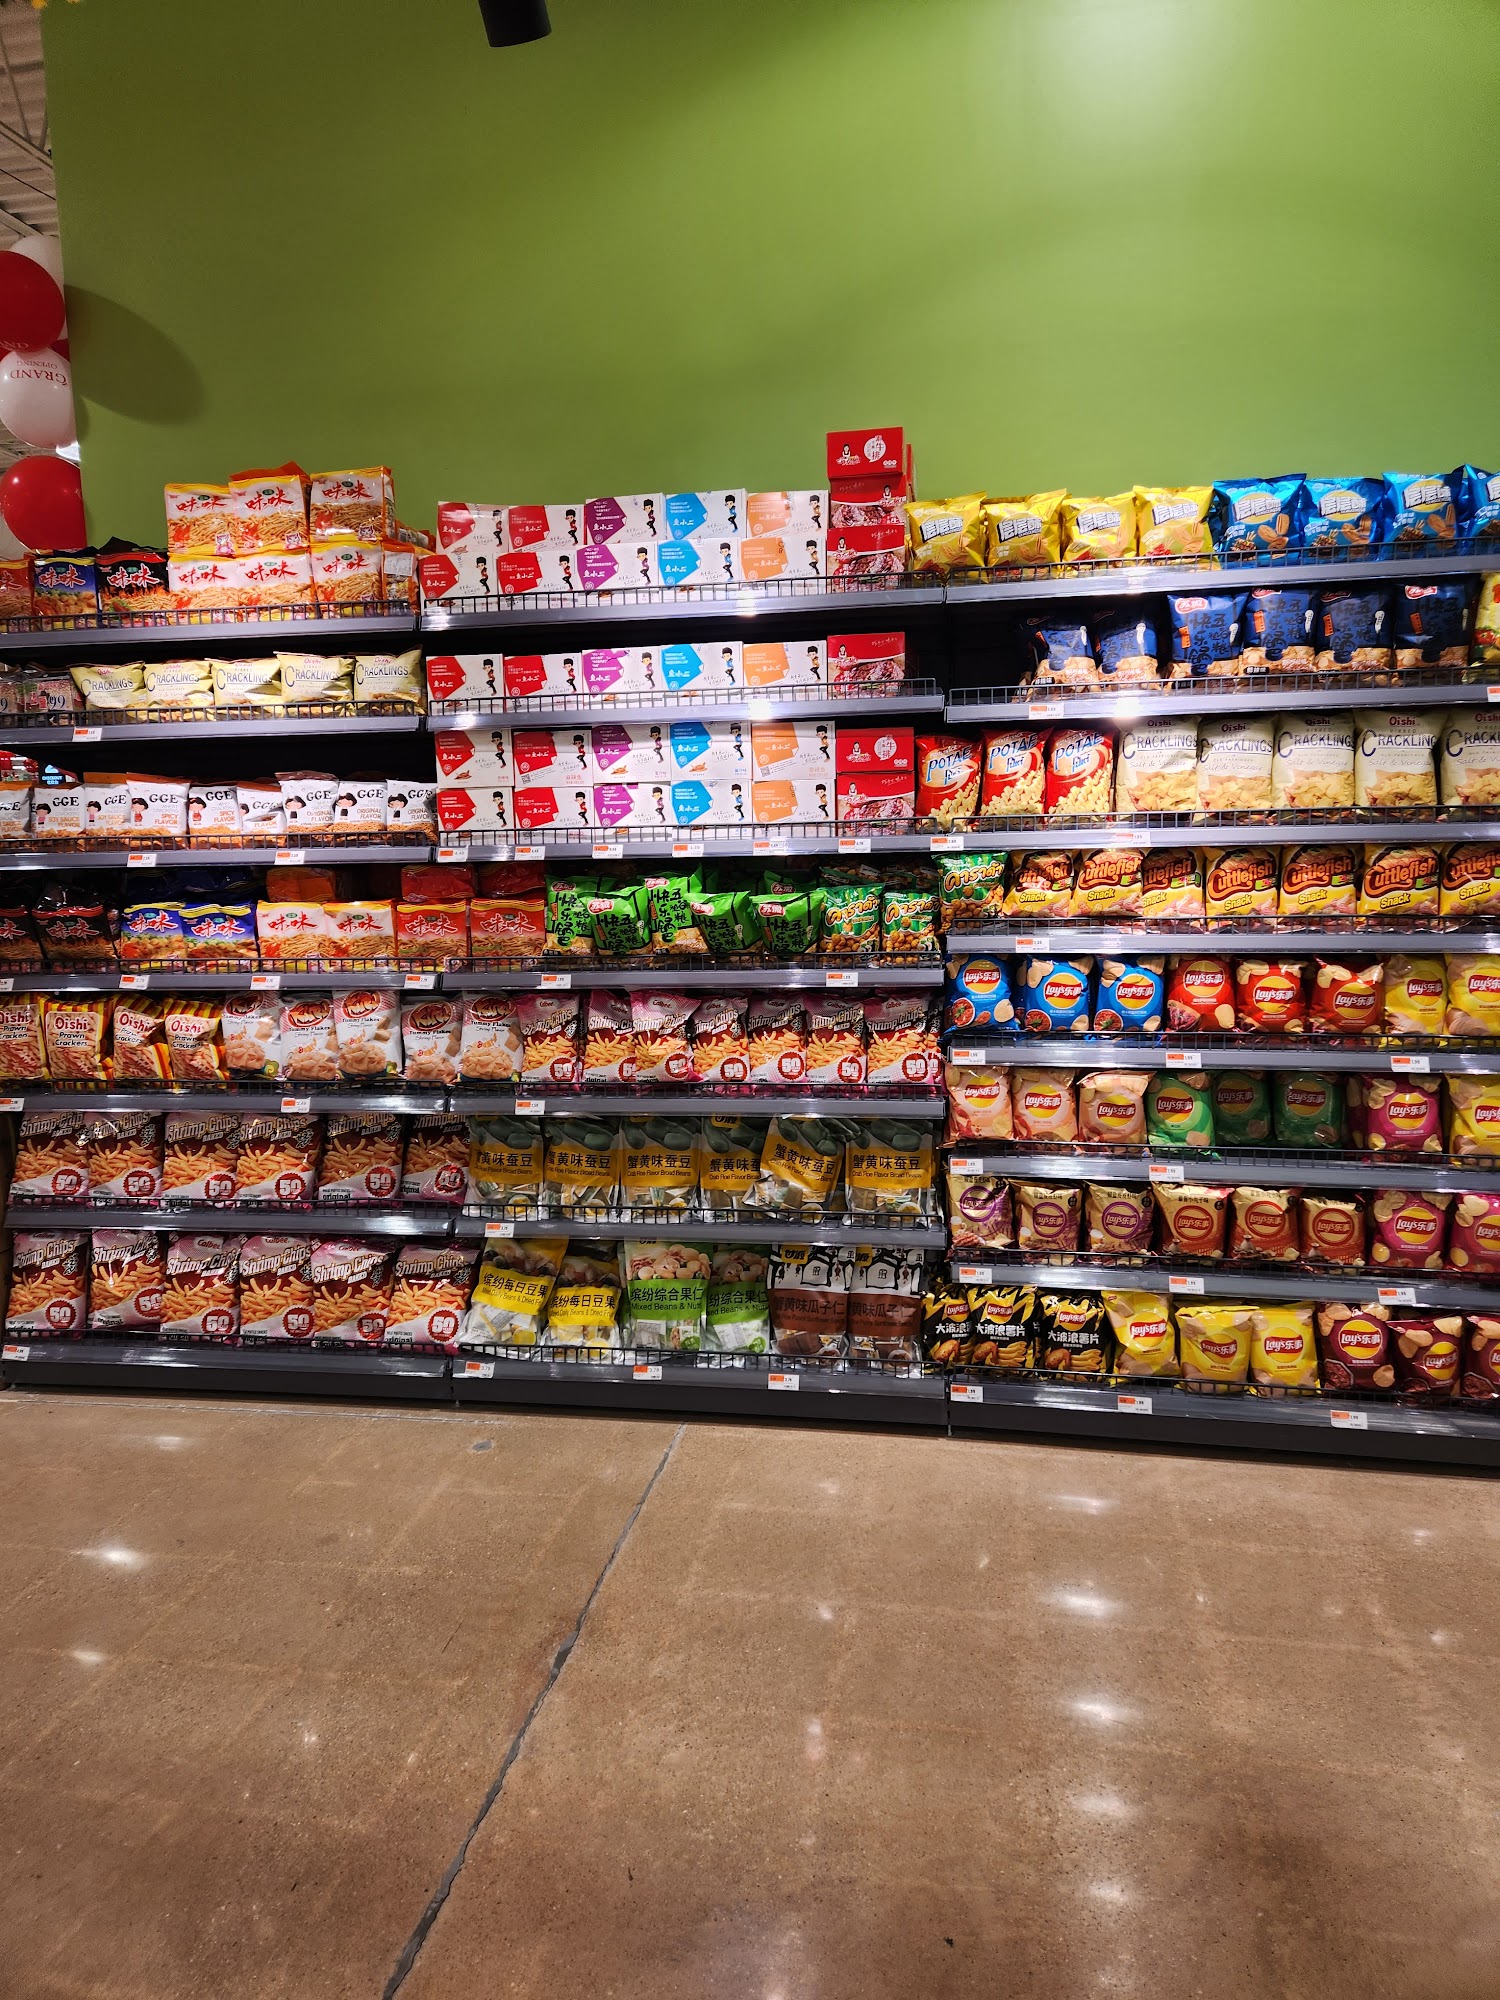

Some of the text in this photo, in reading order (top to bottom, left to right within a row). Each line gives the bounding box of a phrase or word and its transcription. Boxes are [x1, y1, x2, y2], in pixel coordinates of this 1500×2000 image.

[16, 360, 59, 370] OPENING
[10, 368, 68, 385] GRAND
[1148, 720, 1172, 729] Oishi
[1222, 723, 1246, 733] Oishi
[1305, 717, 1330, 726] Oishi
[1389, 716, 1416, 726] Oishi
[989, 733, 1039, 769] POTAE
[1055, 733, 1104, 772] POTAE
[927, 746, 972, 782] POTAE
[53, 796, 80, 807] GGE
[105, 794, 127, 805] GGE
[149, 794, 179, 804] GGE
[206, 790, 233, 801] GGE
[306, 791, 332, 801] GGE
[357, 789, 384, 799] GGE
[1208, 861, 1273, 900] Cuttlefish
[1283, 857, 1350, 895] Cuttlefish
[1364, 857, 1436, 897] Cuttlefish
[1019, 891, 1047, 902] Snack
[1088, 888, 1115, 901] Snack
[1298, 889, 1327, 905] Snack
[1459, 882, 1490, 900] Snack
[1224, 895, 1252, 910] Snack
[1380, 893, 1410, 909] Snack
[1256, 989, 1295, 1001] Lay's乐事
[1336, 995, 1375, 1007] Lay's乐事
[55, 1017, 88, 1030] Oishi
[716, 1008, 739, 1025] Chips
[171, 1020, 204, 1033] Oishi
[866, 1017, 898, 1033] Shrimp
[55, 1039, 88, 1047] Crackers
[724, 1063, 743, 1078] 50
[782, 1056, 801, 1073] 50
[905, 1059, 925, 1074] 50
[20, 1118, 57, 1137] Shrimp
[52, 1128, 73, 1138] BAKED
[167, 1115, 239, 1143] Shrimp Chips
[361, 1125, 382, 1136] BAKED
[202, 1132, 224, 1142] BAKED
[628, 1154, 691, 1169] 蟹黄味蚕豆
[774, 1142, 836, 1174] 蟹黄味蚕豆
[852, 1154, 921, 1171] 蟹黄味蚕豆
[56, 1174, 78, 1190] 50
[370, 1173, 391, 1188] 50
[1397, 1218, 1436, 1231] Lay's乐事
[16, 1239, 76, 1269] Shrimp Chips
[242, 1255, 281, 1276] Shrimp
[314, 1254, 384, 1284] Shrimp Chips
[347, 1272, 368, 1284] BAKED
[483, 1272, 548, 1299] 缤纷每日豆果
[551, 1294, 616, 1310] 缤纷每日豆果
[631, 1287, 704, 1302] 缤纷综合果仁
[631, 1302, 653, 1311] Mixed
[654, 1303, 678, 1311] Beans
[50, 1306, 72, 1323] 50
[432, 1315, 455, 1331] 50
[976, 1323, 1026, 1337] 大波浪薯片
[1048, 1330, 1100, 1345] 大波浪薯片
[1265, 1338, 1303, 1351] Lay's乐事
[1341, 1333, 1381, 1345] Lay's乐事
